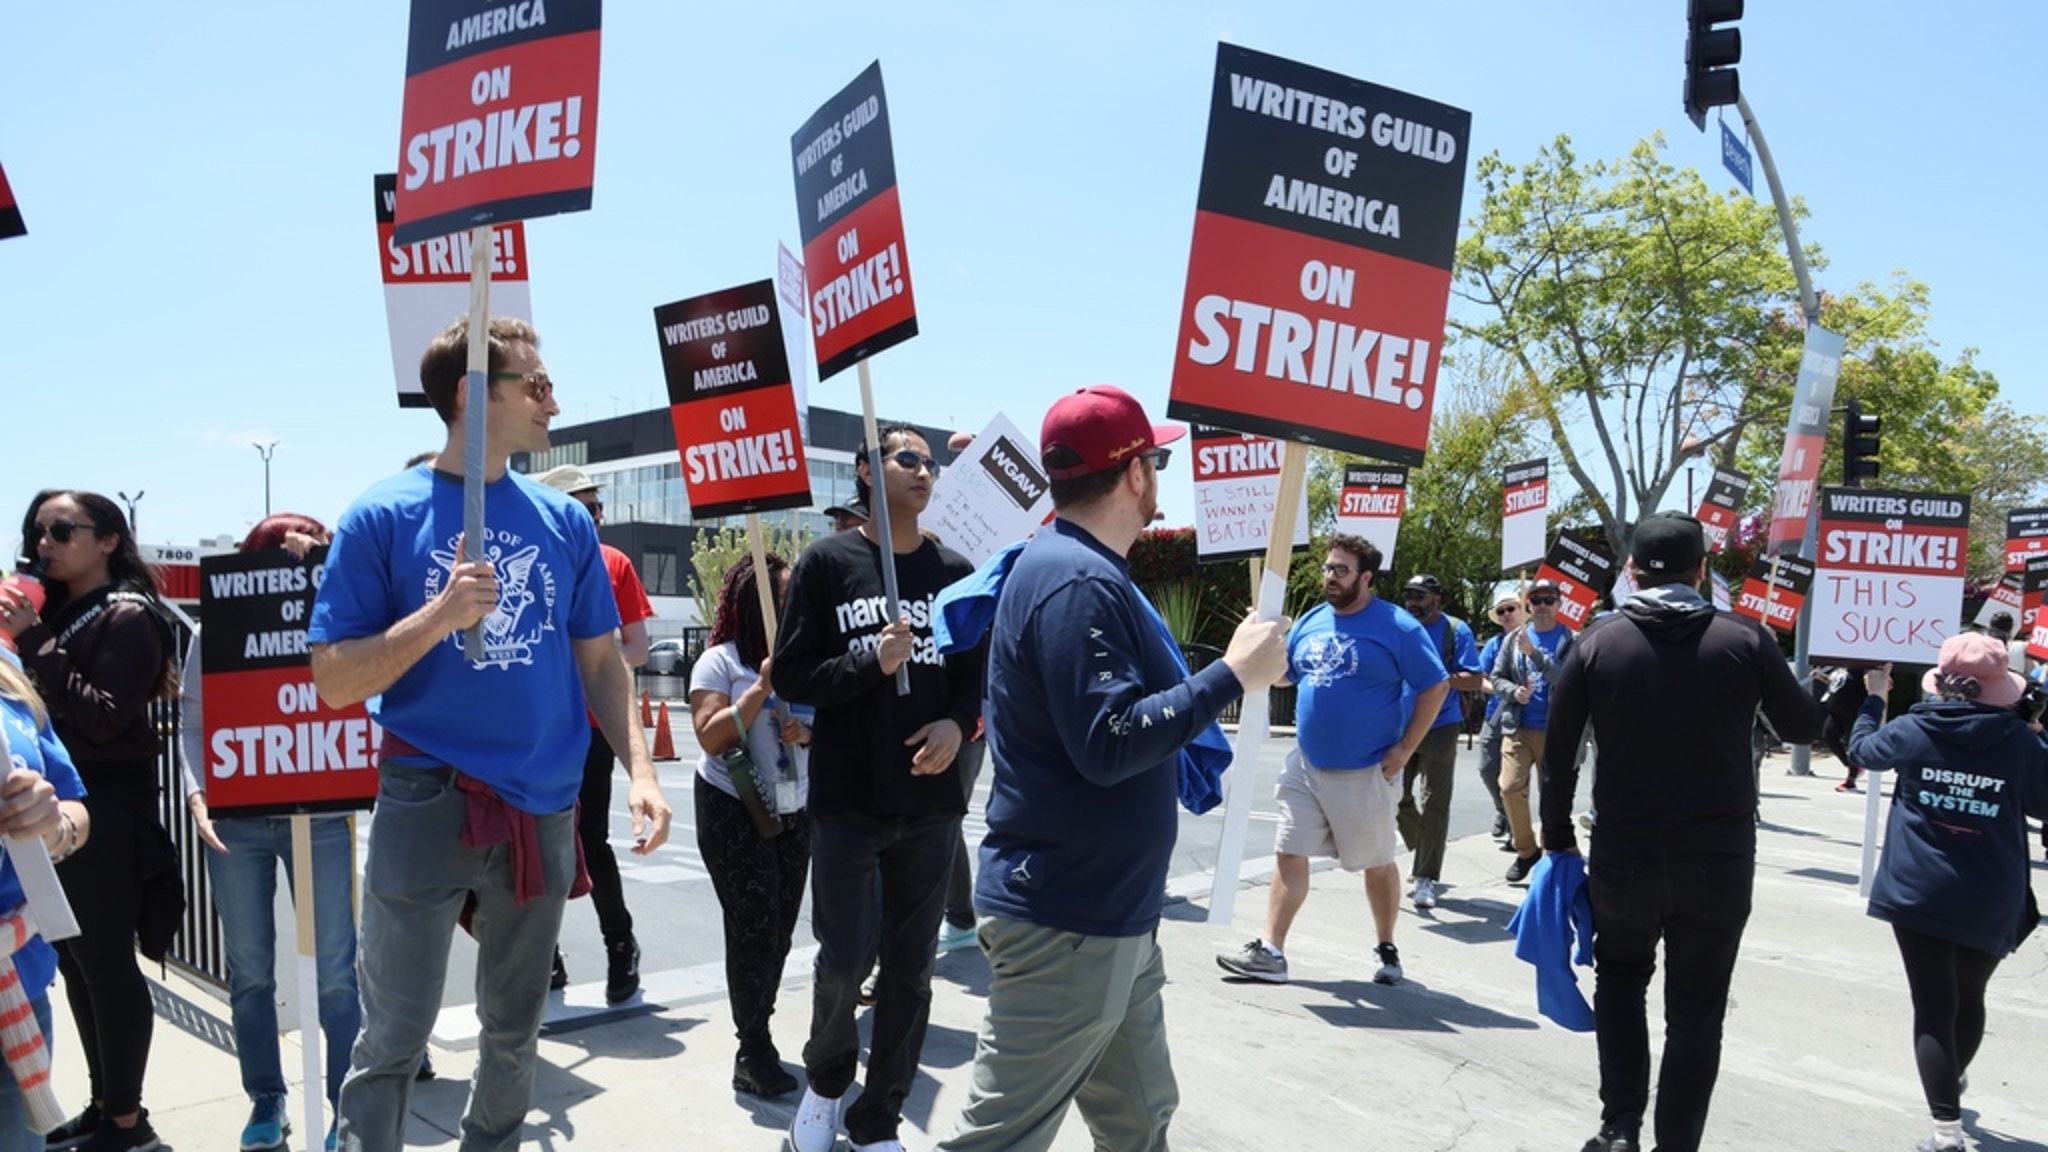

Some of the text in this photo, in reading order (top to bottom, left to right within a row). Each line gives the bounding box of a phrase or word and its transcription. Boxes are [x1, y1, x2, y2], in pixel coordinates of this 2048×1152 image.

[446, 0, 547, 51] AMERICA
[471, 65, 511, 106] ON
[797, 95, 879, 175] WRITERS GUILD
[1229, 73, 1456, 164] WRITERS GUILD
[405, 95, 582, 190] STRIKE!
[830, 153, 843, 178] OF
[1324, 147, 1358, 178] OF
[817, 168, 868, 223] AMERICA
[1263, 174, 1401, 238] AMERICA
[837, 227, 859, 265] ON
[812, 241, 904, 337] STRIKE!
[1299, 260, 1355, 308] ON
[663, 304, 770, 346] WRITERS GUILD
[711, 341, 727, 360] OF
[1188, 294, 1430, 411] STRIKE!
[693, 360, 757, 391] AMERICA
[719, 406, 747, 432] ON
[685, 429, 798, 485] STRIKE!
[990, 445, 1042, 499] WGAW
[1198, 441, 1284, 475] STRIK
[1205, 502, 1257, 520] WANNA
[1343, 492, 1401, 515] STRIKE!
[1506, 484, 1545, 513] STRIKE!
[1830, 494, 1963, 518] WRITERS GUILD
[498, 530, 523, 547] OF
[1207, 519, 1268, 545] BATGI
[1885, 518, 1904, 531] ON
[156, 549, 194, 560] 7800
[1825, 530, 1959, 571] STRIKE!
[210, 566, 308, 599] WRITERS
[1828, 576, 1917, 609] THIS
[281, 600, 305, 622] OF
[244, 629, 313, 659] AMER
[1835, 611, 1946, 649] SUCKS
[278, 683, 317, 715] ON
[211, 718, 383, 779] STRIKE!
[1921, 767, 2005, 793] DISRUPT
[1948, 785, 1975, 798] THE
[1918, 790, 2000, 818] SYSTEM
